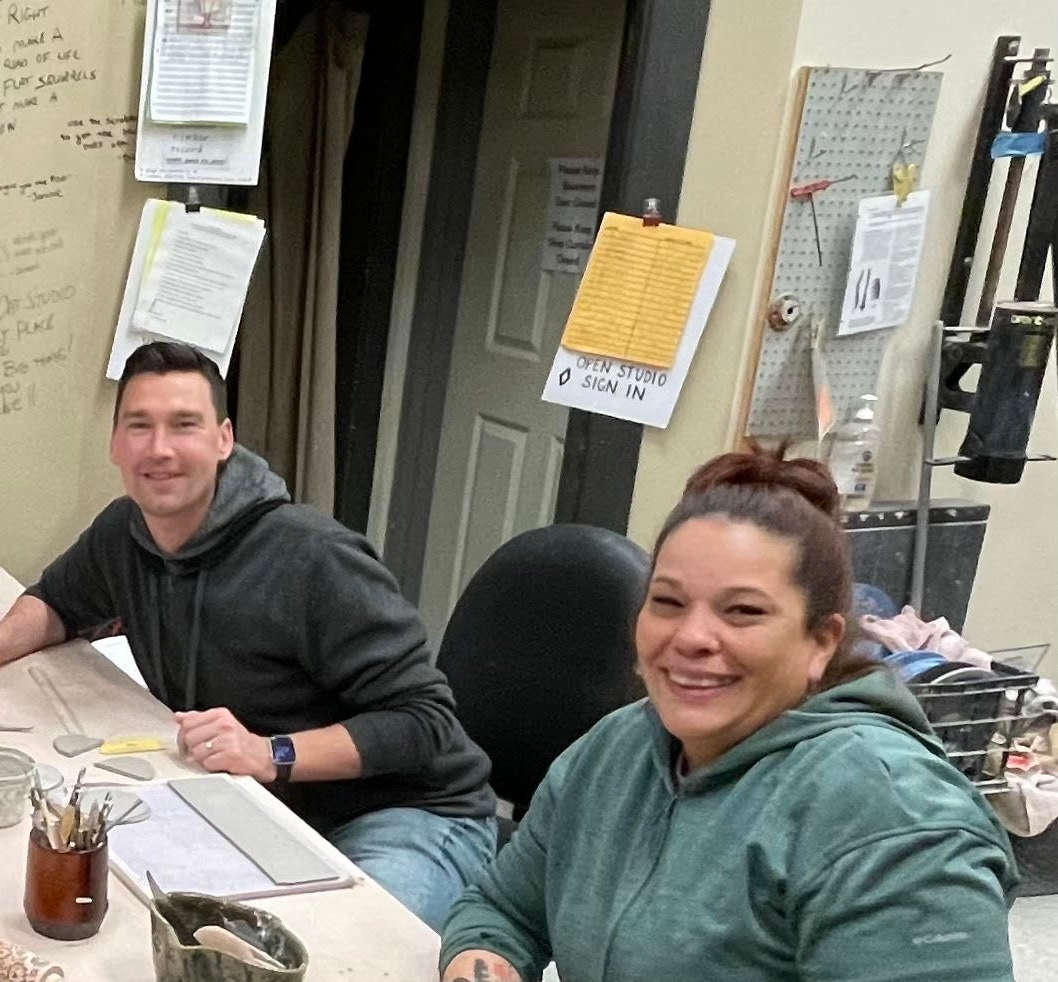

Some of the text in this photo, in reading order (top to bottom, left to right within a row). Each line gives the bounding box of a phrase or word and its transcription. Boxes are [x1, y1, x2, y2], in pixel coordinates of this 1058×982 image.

[8, 4, 49, 24] RIGHT
[53, 27, 63, 42] A
[576, 356, 667, 387] OPEN STUDIO
[582, 374, 646, 400] SIGN IN
